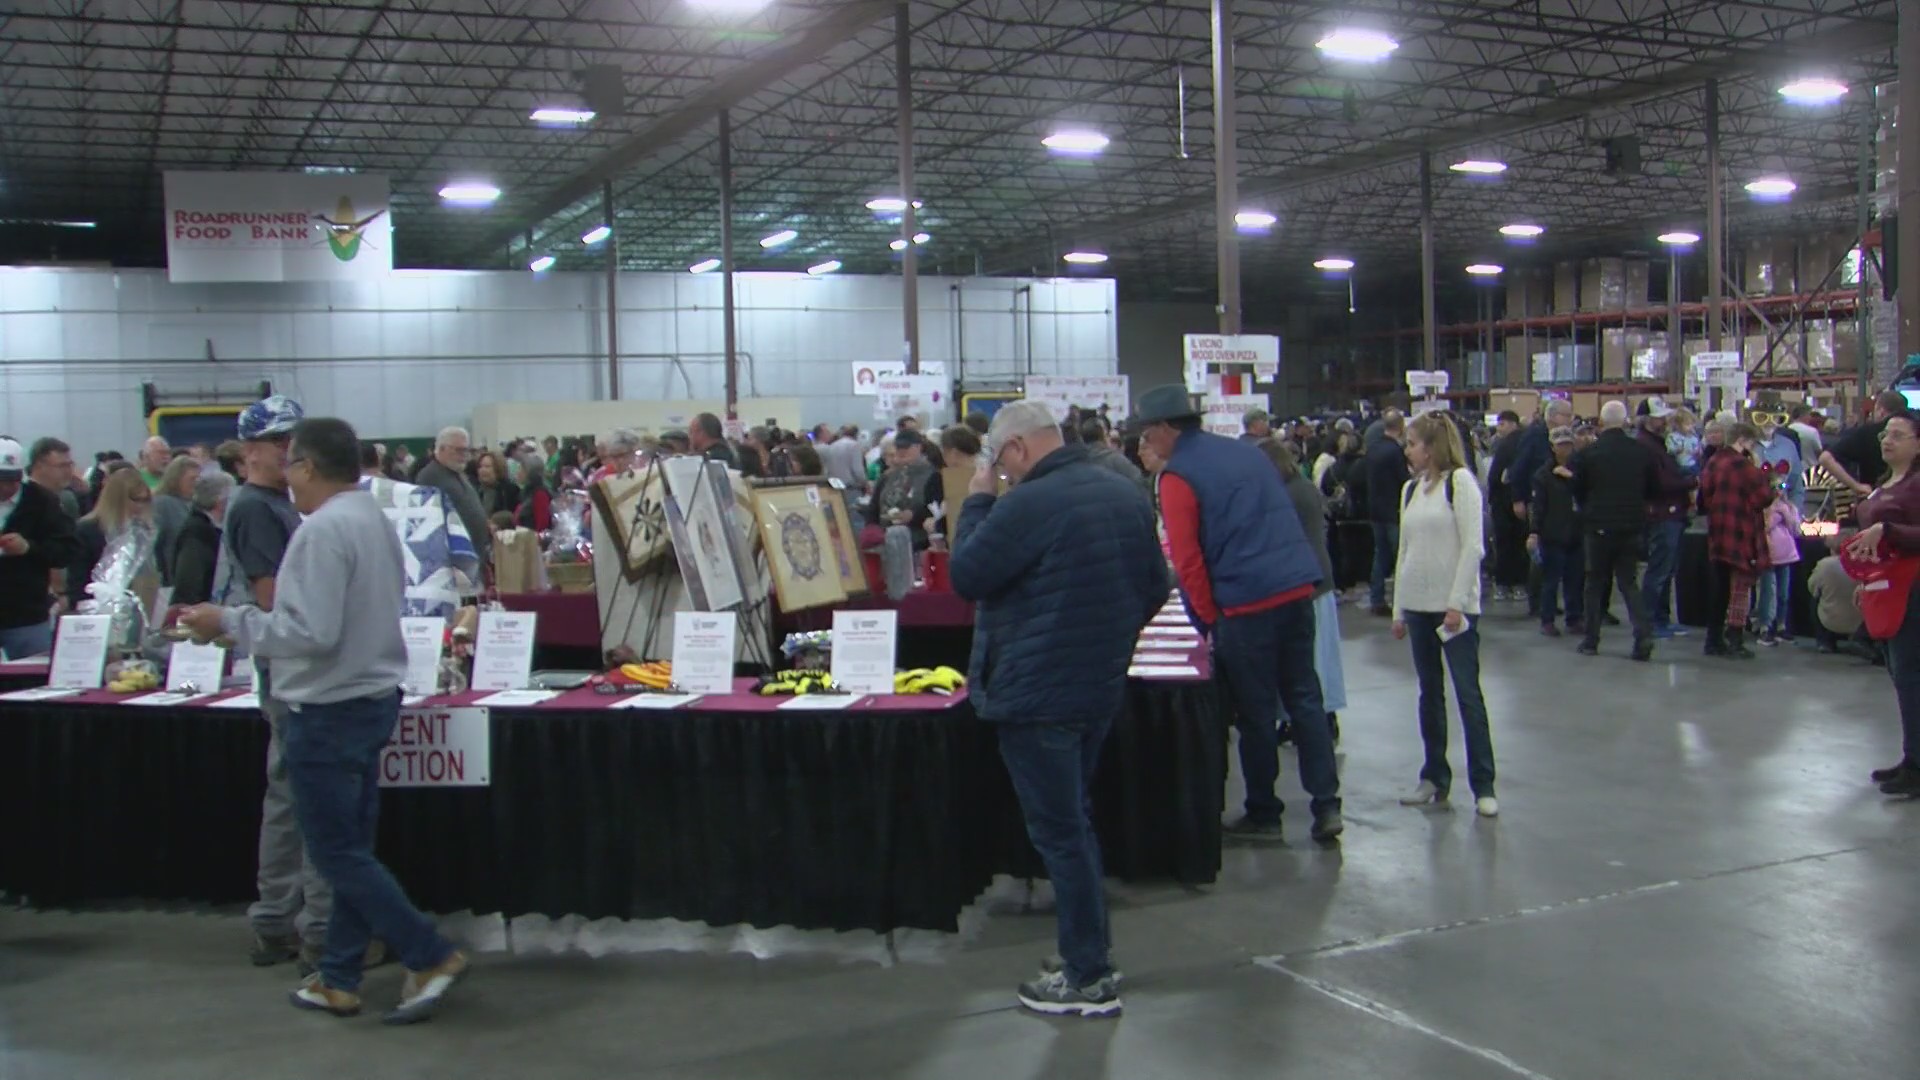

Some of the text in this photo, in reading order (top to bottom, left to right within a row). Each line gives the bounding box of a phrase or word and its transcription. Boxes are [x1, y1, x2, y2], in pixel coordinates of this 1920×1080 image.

[174, 209, 308, 224] ROADRUNNER
[174, 225, 308, 239] FOOD BANK
[1191, 350, 1258, 361] WOOD OVEN PIZZA
[389, 713, 451, 746] ENT
[383, 749, 464, 782] CTION
